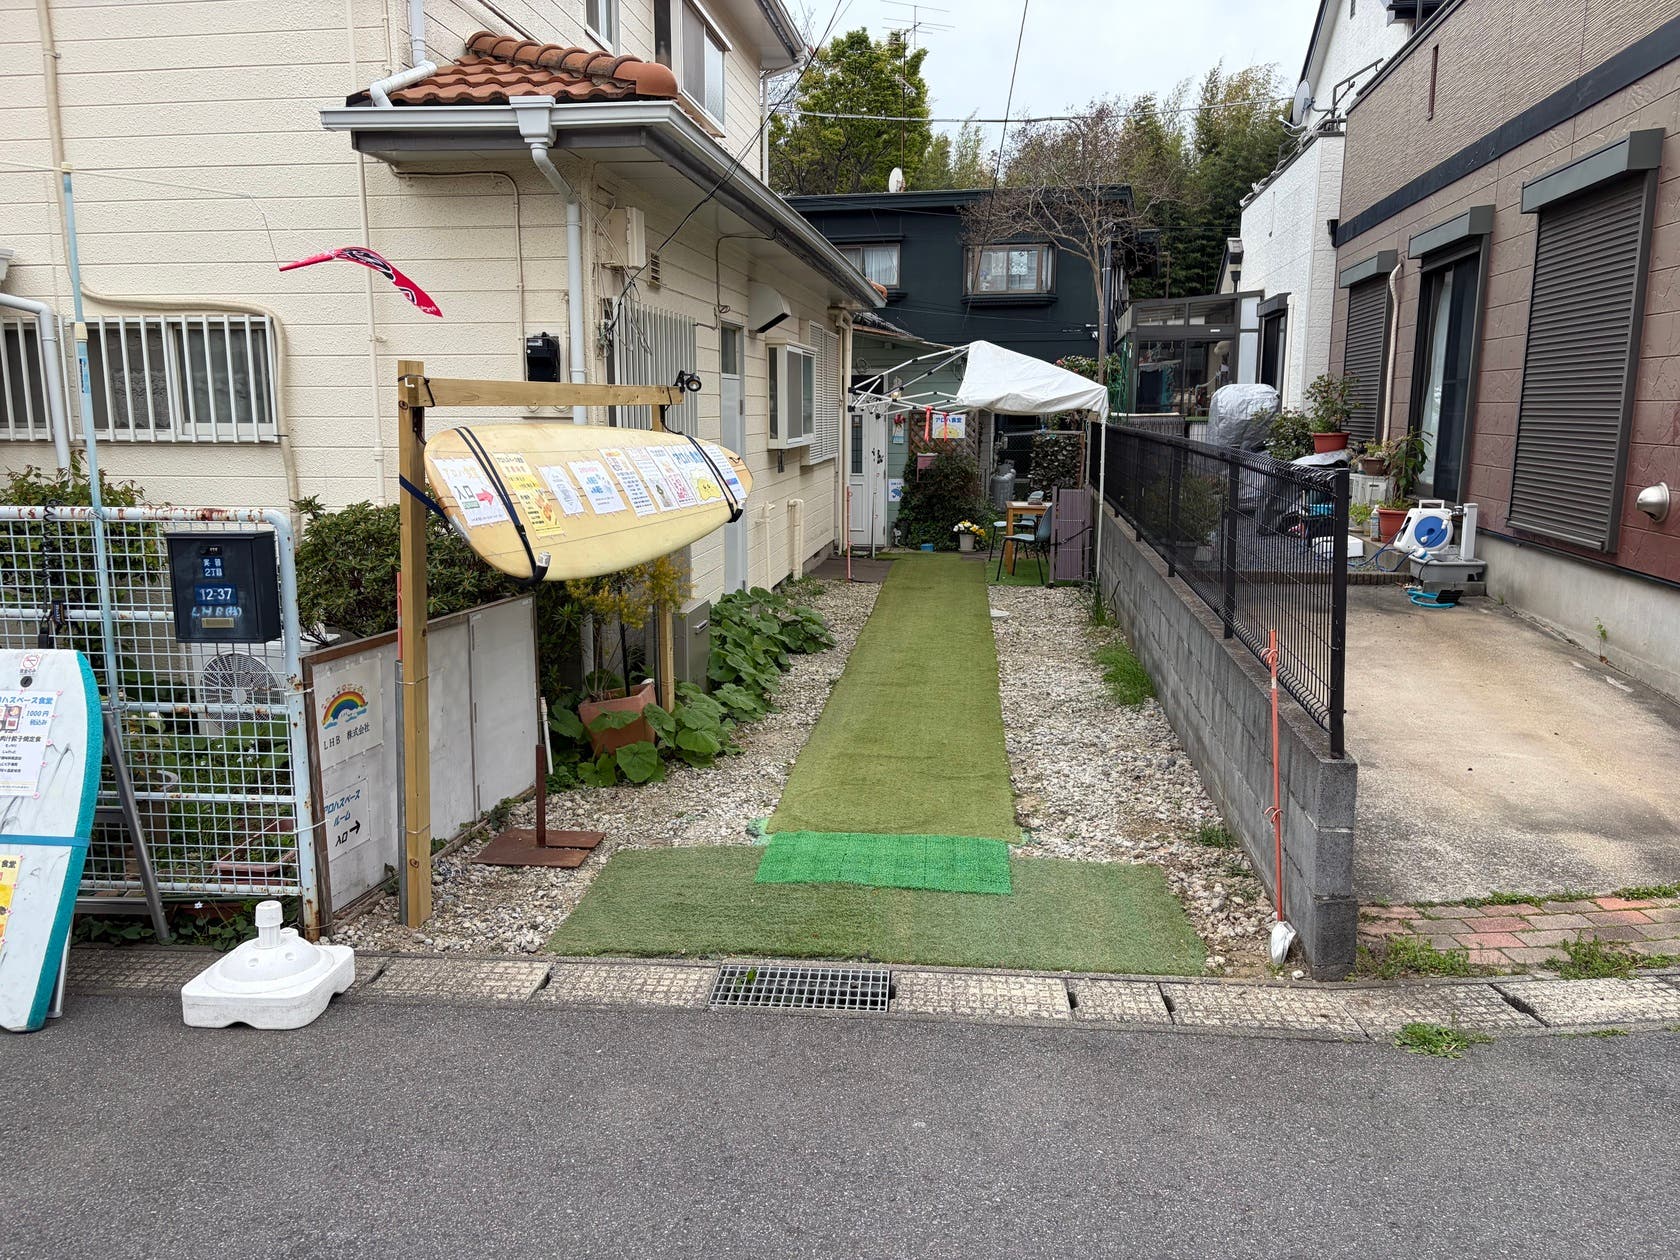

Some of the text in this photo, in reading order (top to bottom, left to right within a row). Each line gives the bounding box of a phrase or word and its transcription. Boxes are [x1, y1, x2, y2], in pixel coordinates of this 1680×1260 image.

[454, 485, 475, 500] 入口
[200, 588, 232, 600] 12-37
[323, 722, 370, 750] LHB 株式会社
[333, 810, 351, 827] ルーム
[334, 831, 349, 848] 入口
